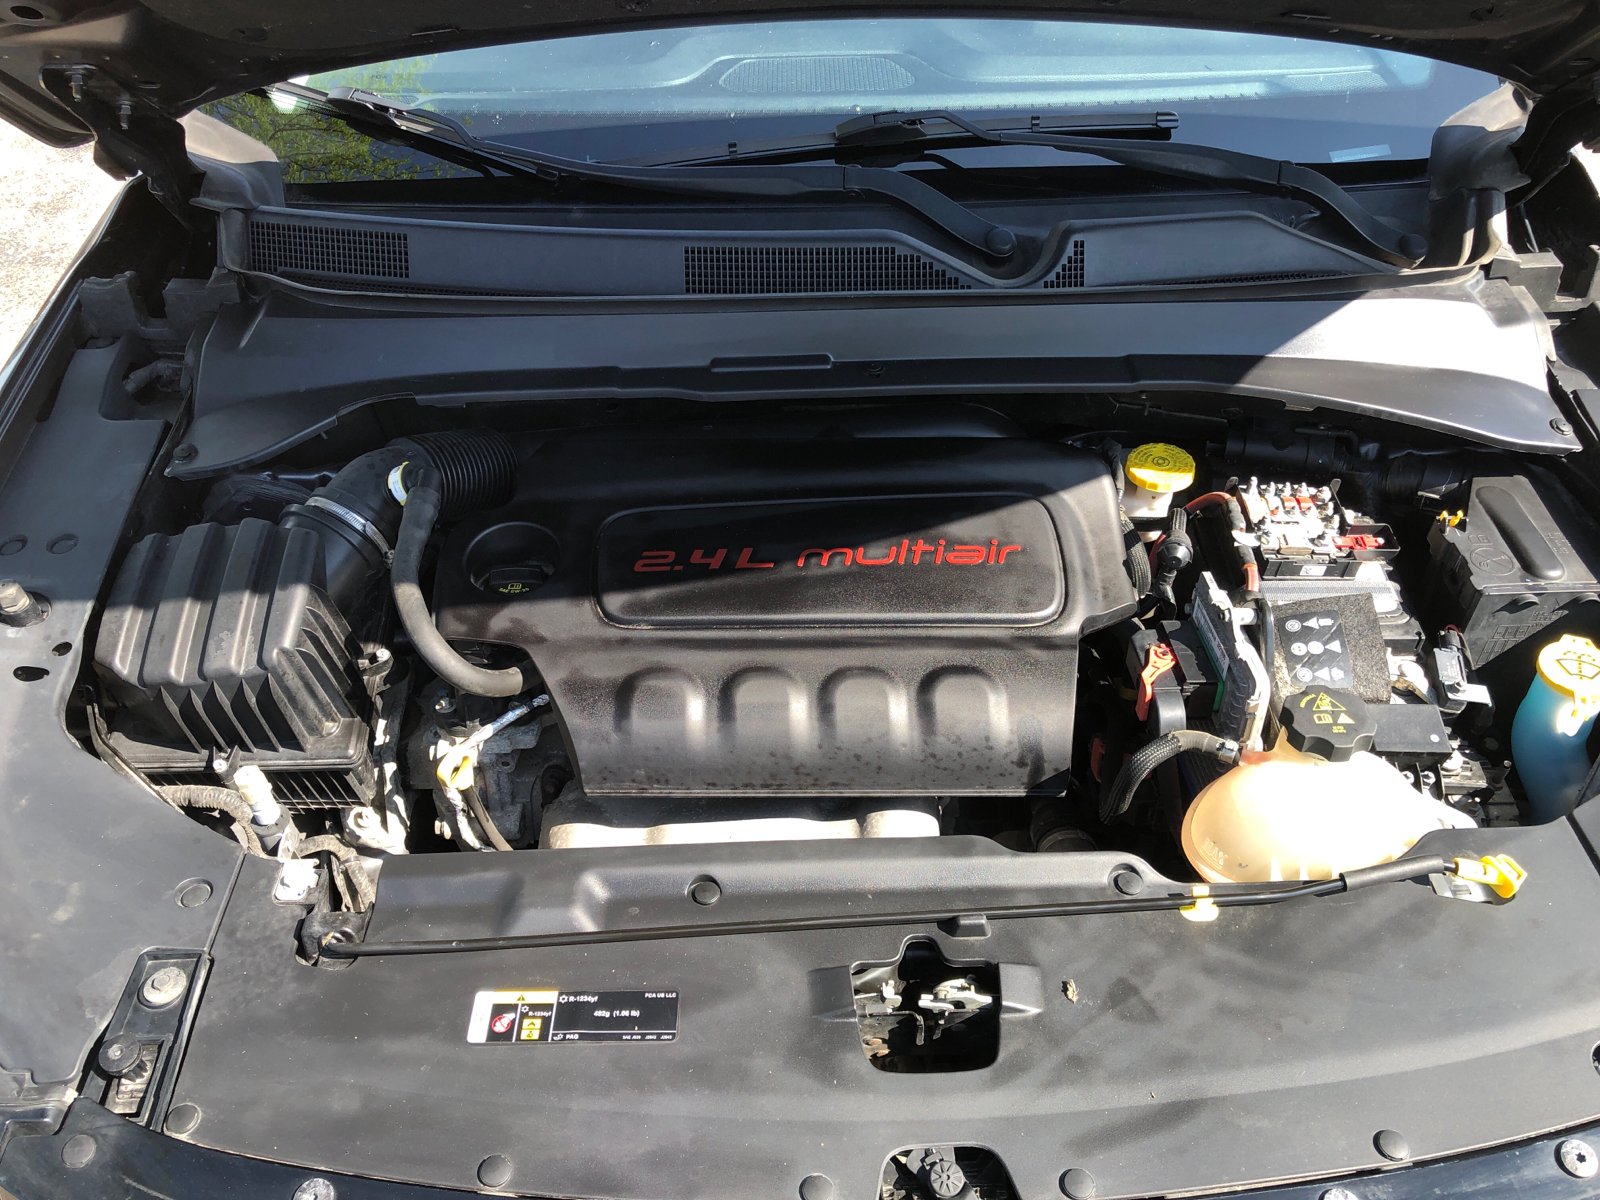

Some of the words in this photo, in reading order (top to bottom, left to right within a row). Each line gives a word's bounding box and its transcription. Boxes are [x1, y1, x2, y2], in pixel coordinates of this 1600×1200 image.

[797, 539, 1021, 567] multiair
[1201, 837, 1228, 866] MAX
[593, 1010, 611, 1018] 482g
[630, 1010, 640, 1018] lb)
